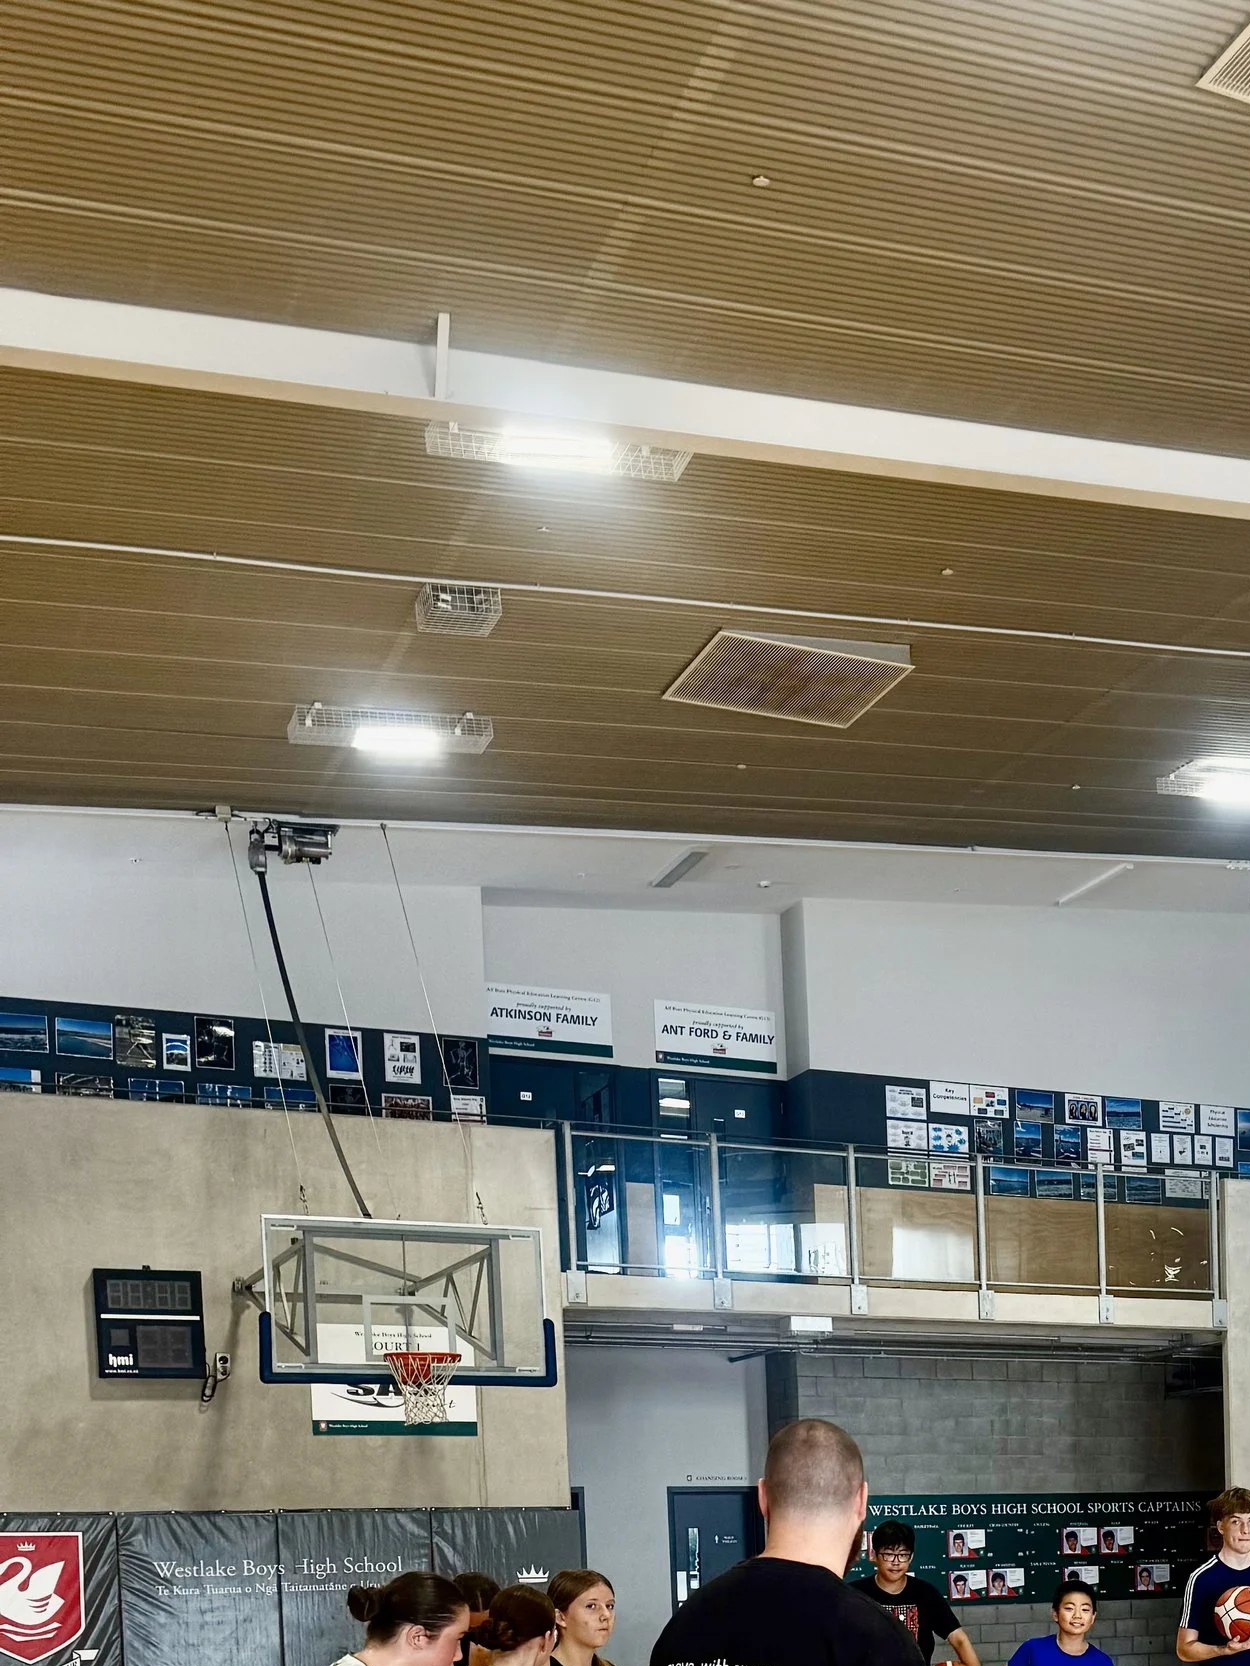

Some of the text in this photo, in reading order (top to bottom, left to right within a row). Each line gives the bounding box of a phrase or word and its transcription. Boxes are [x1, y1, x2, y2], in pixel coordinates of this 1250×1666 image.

[490, 1006, 598, 1027] ATKINSON FAMILY
[661, 1024, 775, 1045] ANT FORD & FAMILY
[108, 1353, 134, 1367] hmi
[868, 1501, 1202, 1516] WESTLAKE BOYS HIGH SCHOOL SPORTS CAPTAINS
[153, 1556, 403, 1580] Westlake Boys High School
[156, 1585, 170, 1595] Te
[173, 1585, 200, 1596] Kura
[203, 1584, 242, 1595] Tuarua
